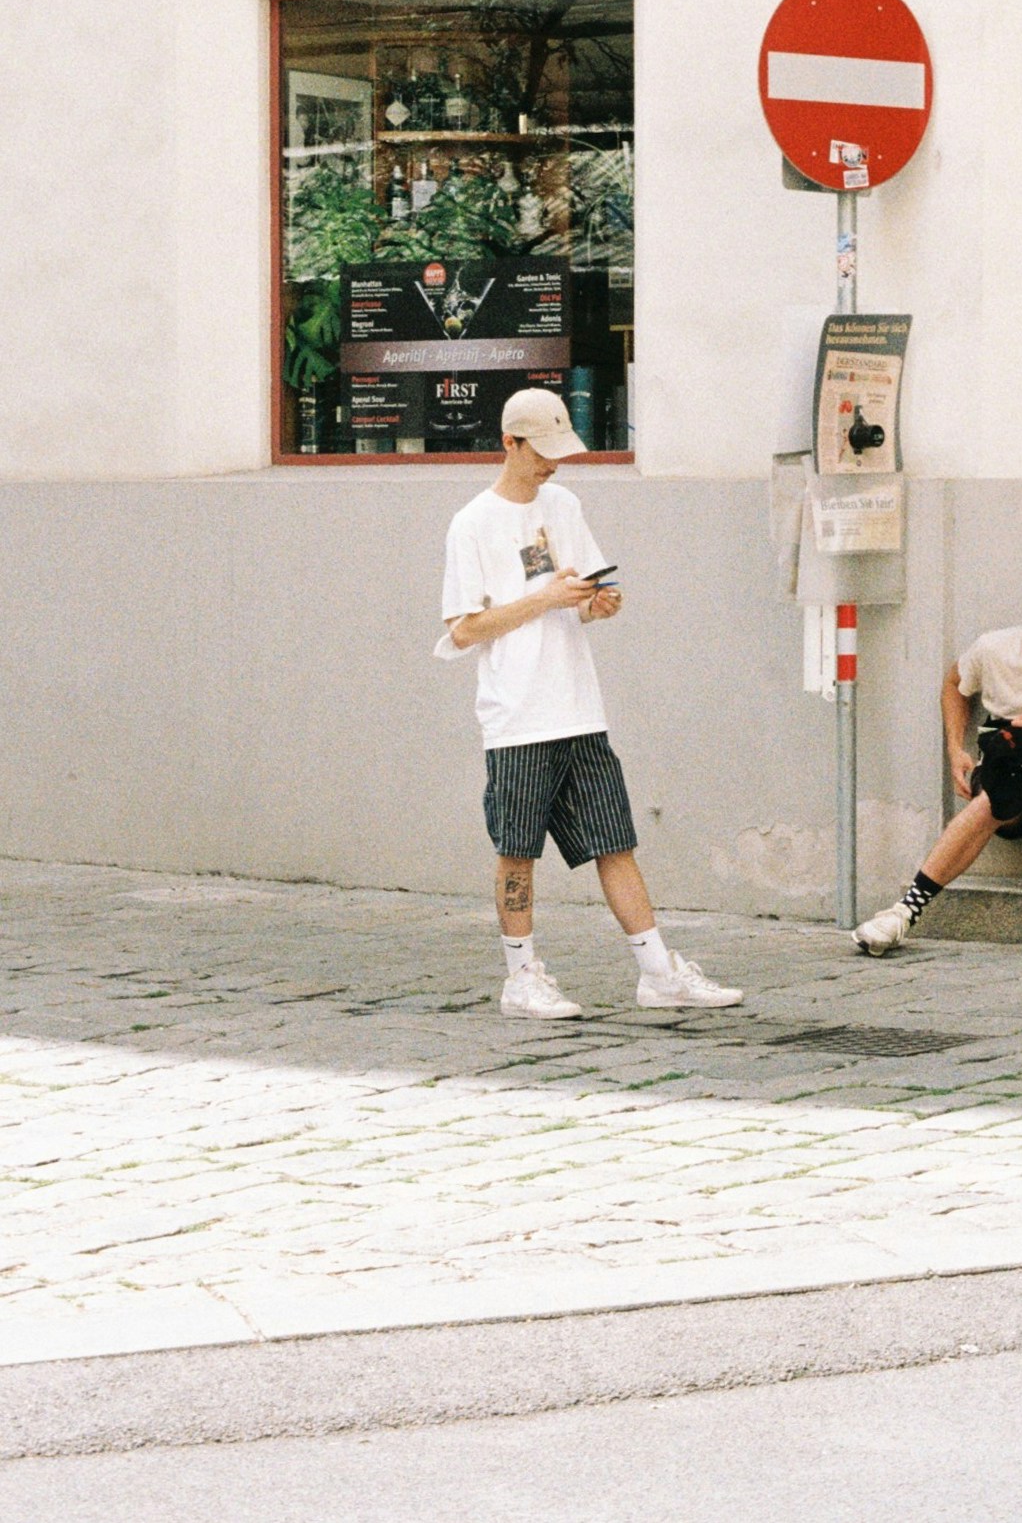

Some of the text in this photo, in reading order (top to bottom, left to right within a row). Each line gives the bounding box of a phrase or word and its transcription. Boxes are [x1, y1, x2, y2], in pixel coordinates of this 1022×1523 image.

[382, 350, 426, 365] Aperitif
[488, 348, 525, 363] Apéro
[436, 378, 479, 398] FIRST
